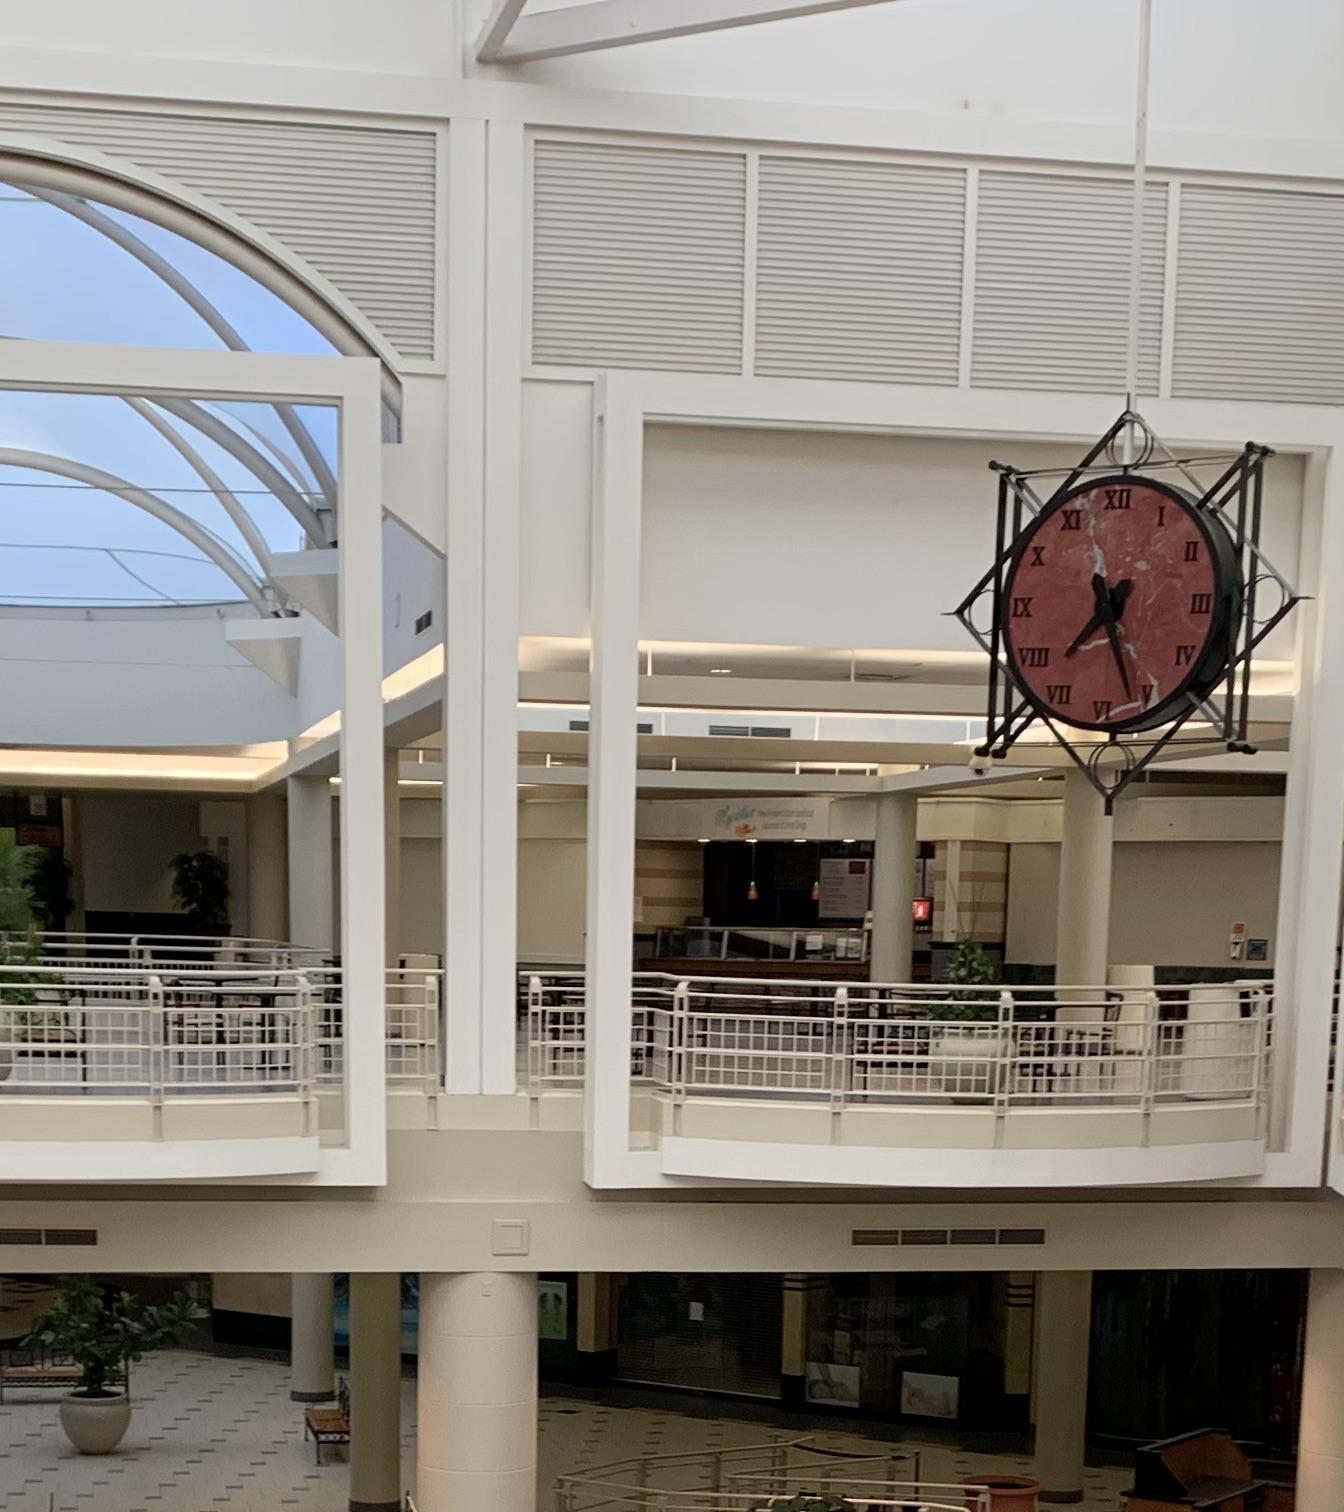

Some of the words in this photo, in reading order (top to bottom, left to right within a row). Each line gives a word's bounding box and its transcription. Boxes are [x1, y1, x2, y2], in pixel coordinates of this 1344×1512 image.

[1103, 489, 1132, 510] XII
[1061, 510, 1082, 530] XI
[1031, 546, 1045, 566] X
[1184, 541, 1199, 561] II
[1012, 597, 1033, 617] IX
[1190, 593, 1212, 614] III
[1018, 648, 1050, 667] VIII
[1175, 645, 1196, 666] IV
[1046, 685, 1072, 705] VII
[1142, 684, 1155, 706] V
[1093, 701, 1112, 721] VI
